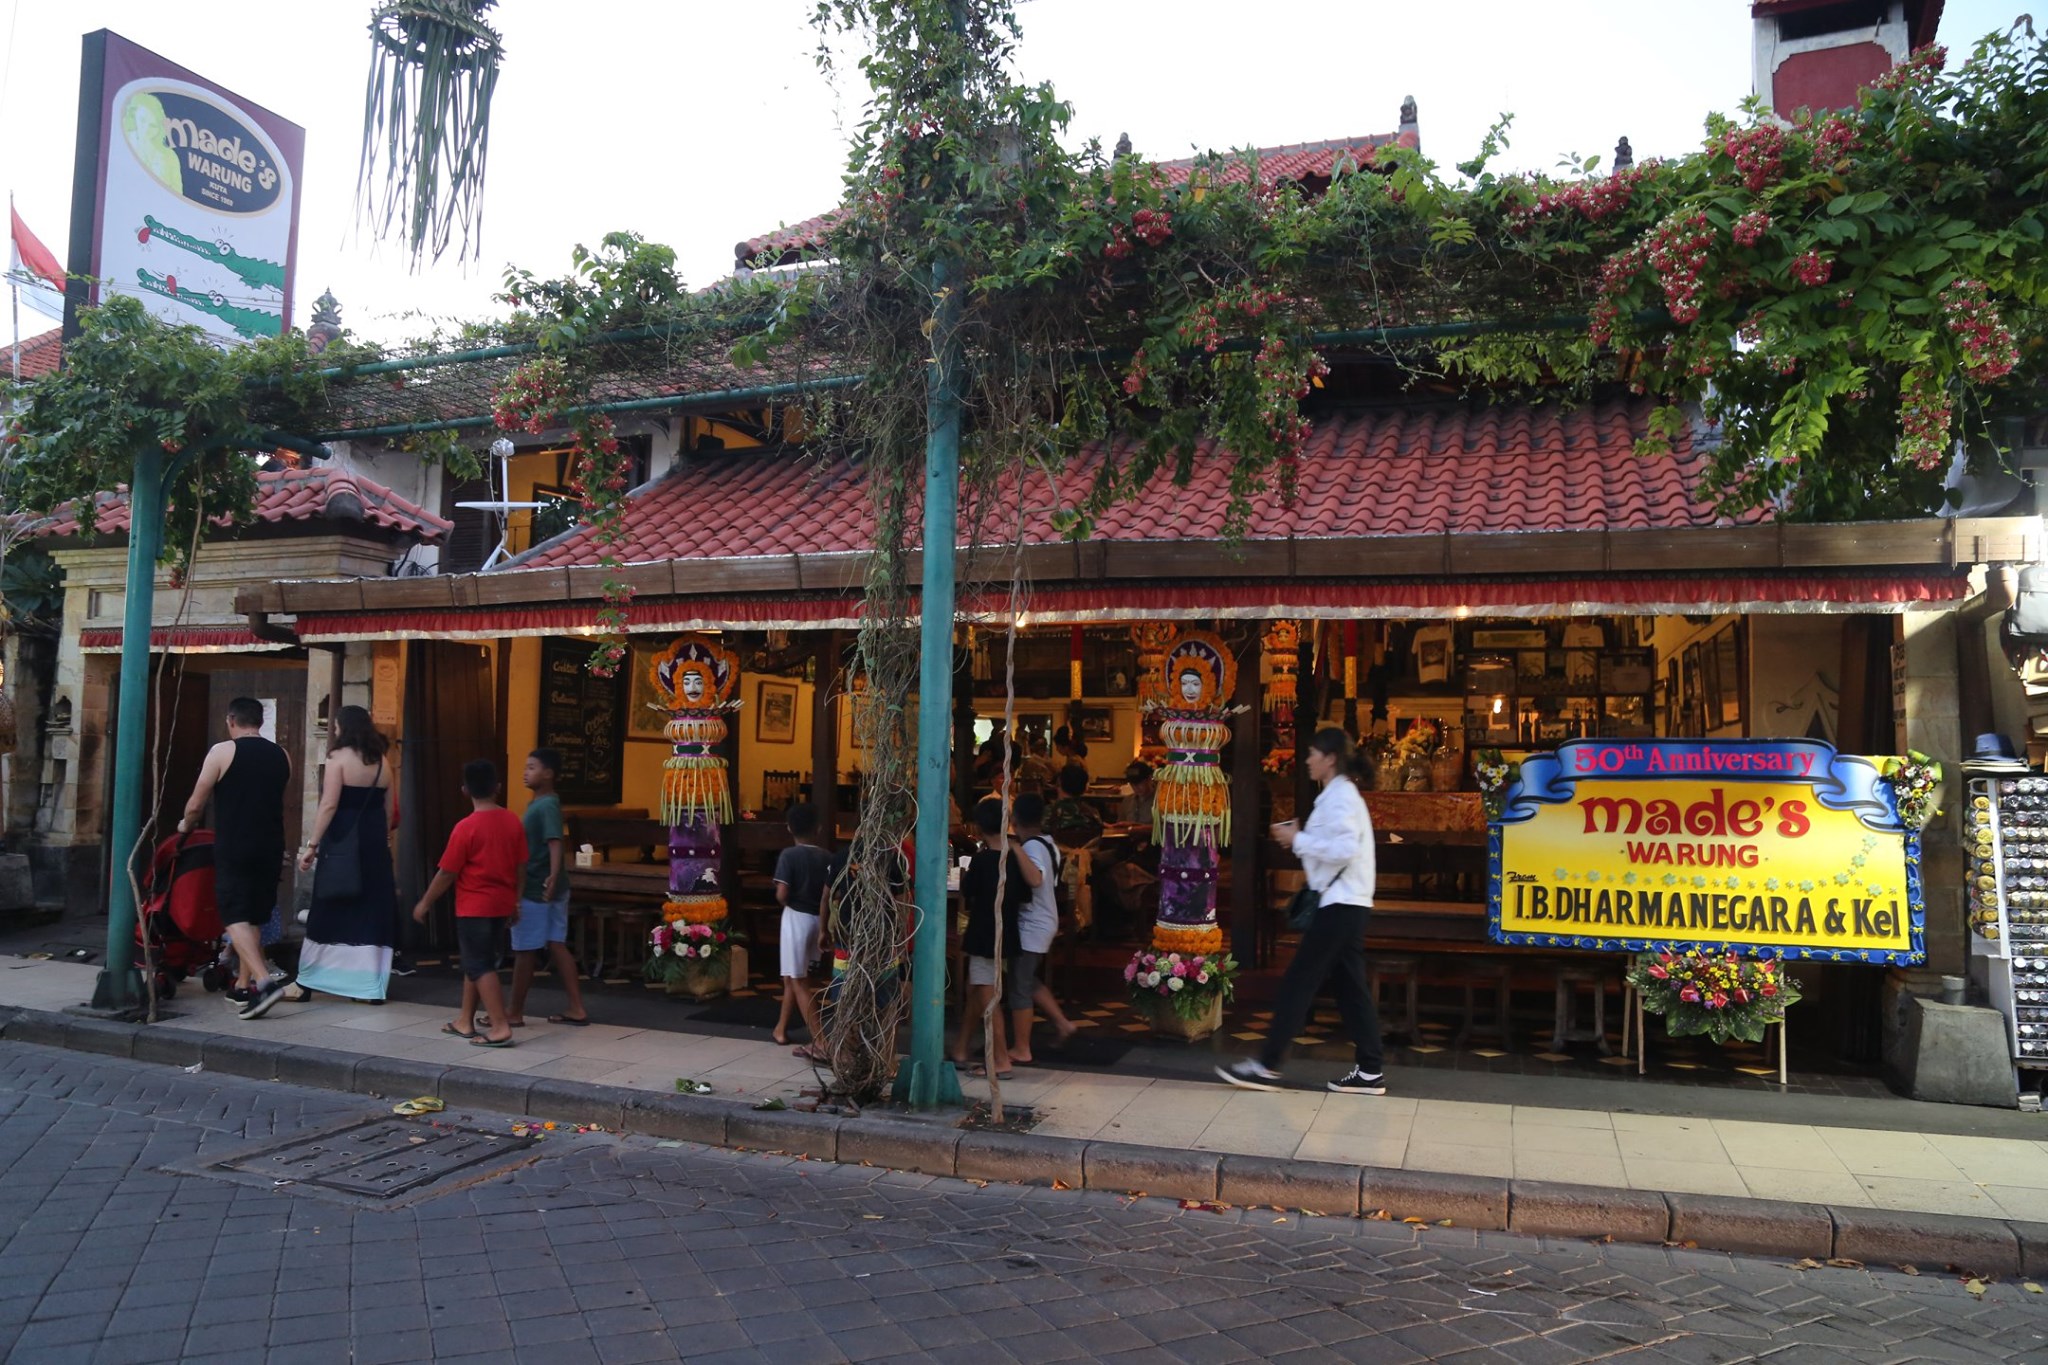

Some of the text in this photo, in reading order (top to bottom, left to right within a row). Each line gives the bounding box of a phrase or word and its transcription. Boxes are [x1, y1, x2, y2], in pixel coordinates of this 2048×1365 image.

[188, 153, 252, 193] WARUNG
[201, 188, 220, 201] SINCE
[209, 181, 228, 194] KUTA
[1575, 745, 1816, 777] 50th Anniversary
[1626, 842, 1758, 868] WARUNG
[1507, 871, 1538, 882] From
[1825, 902, 1846, 933] &
[1853, 898, 1901, 937] Kel
